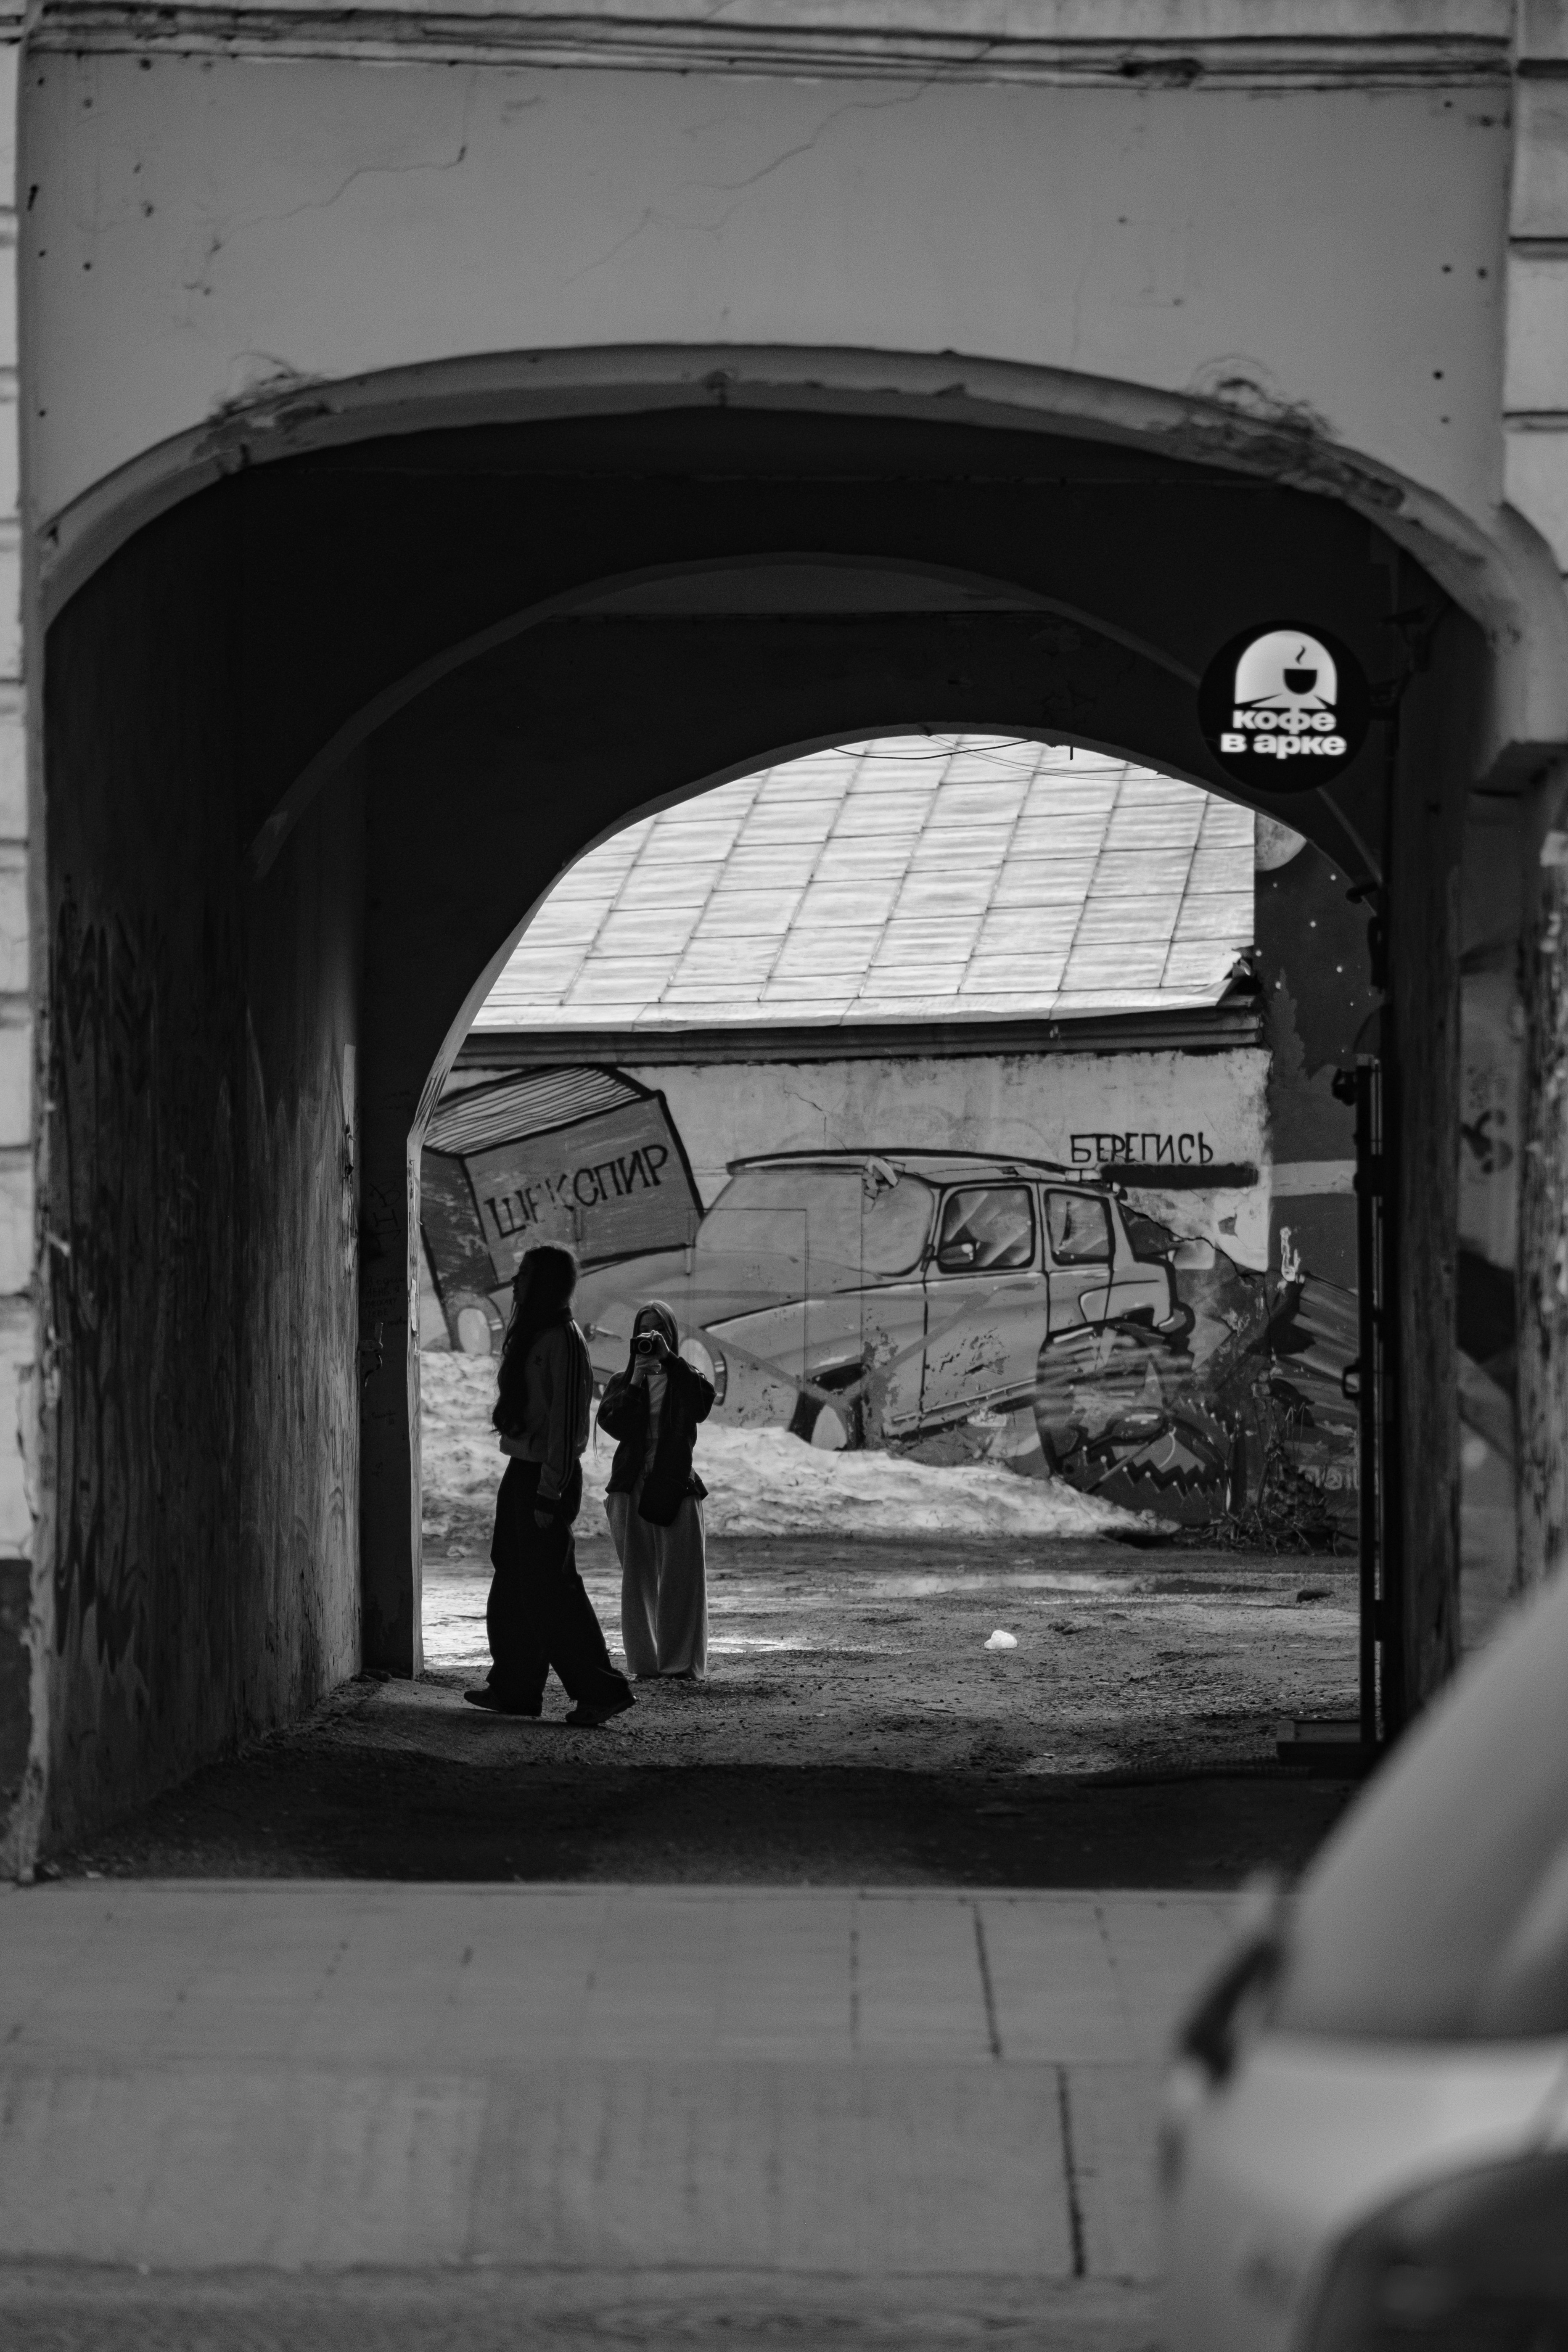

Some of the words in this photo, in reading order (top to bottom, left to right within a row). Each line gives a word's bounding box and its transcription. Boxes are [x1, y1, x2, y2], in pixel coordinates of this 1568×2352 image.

[1232, 708, 1337, 735] кофе
[1220, 733, 1248, 753] в
[1253, 734, 1347, 759] арке
[1070, 1131, 1214, 1164] БЕРЕГИСЬ
